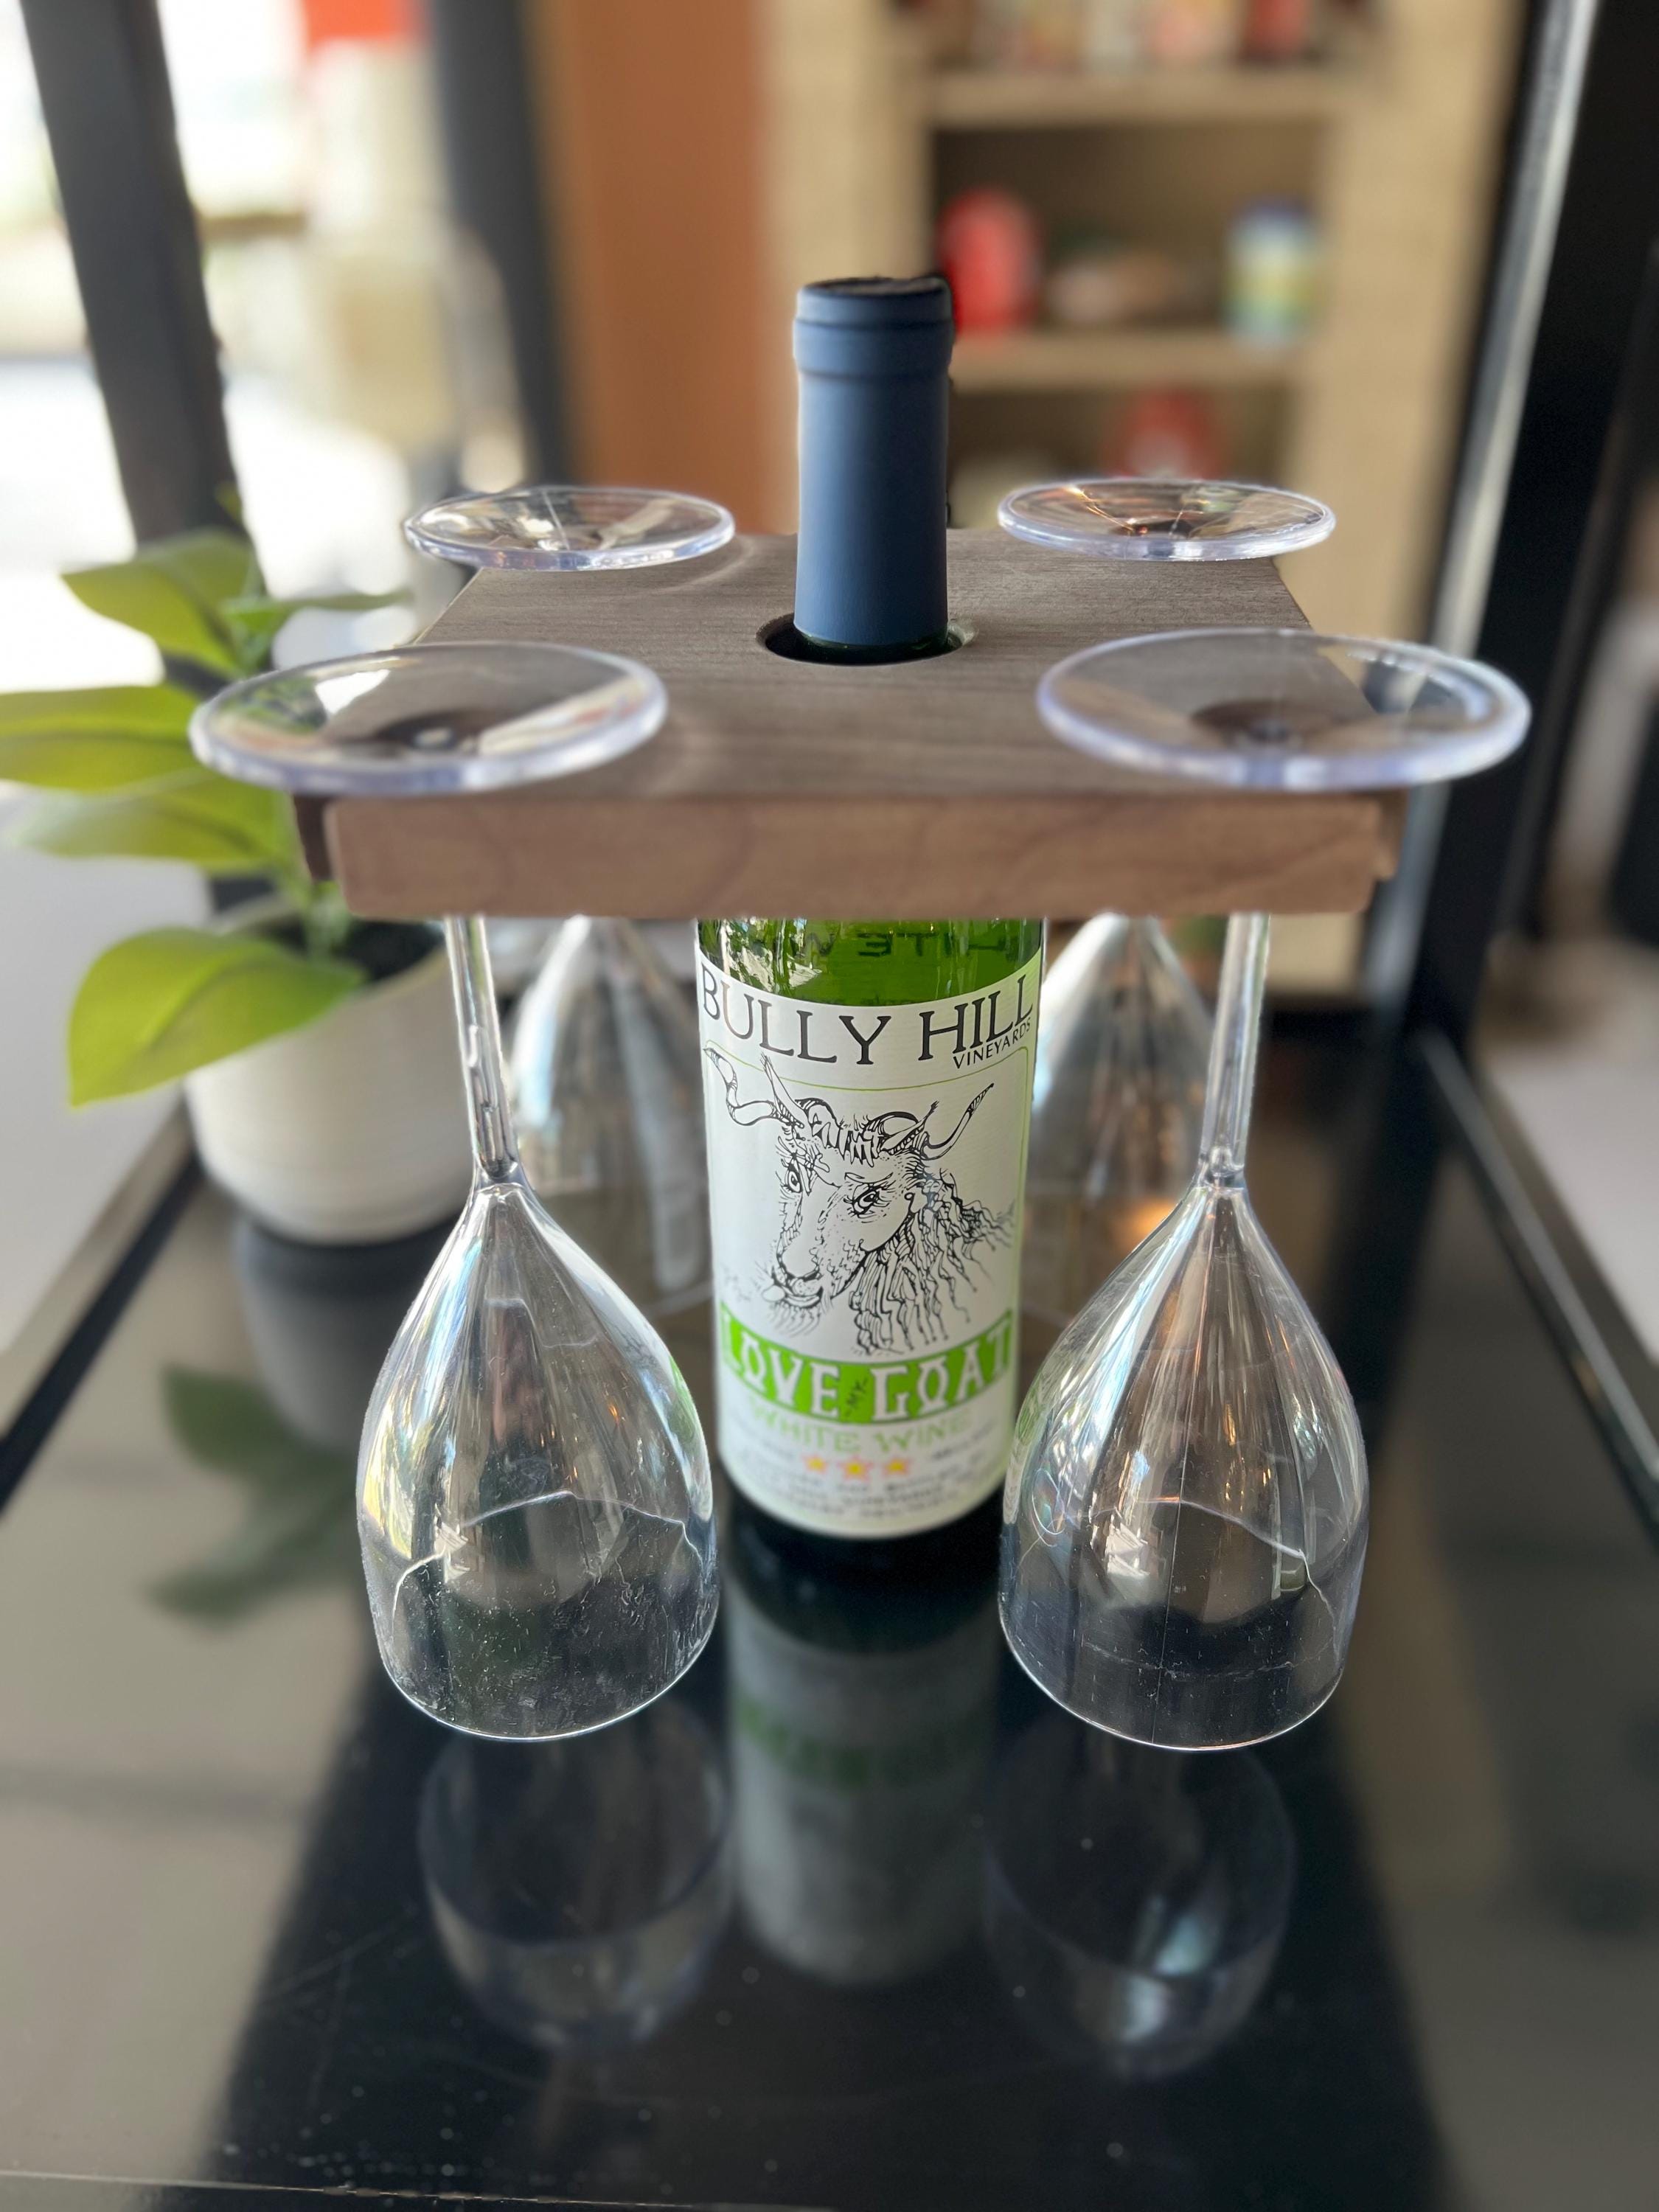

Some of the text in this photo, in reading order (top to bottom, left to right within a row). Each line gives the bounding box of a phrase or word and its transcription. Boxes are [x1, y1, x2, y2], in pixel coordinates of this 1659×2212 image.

[701, 962, 1034, 1065] BULLY HILL
[952, 1016, 1032, 1069] VINEYARDS
[721, 1311, 840, 1419] LOVE
[870, 1315, 1008, 1422] GOAT
[751, 1403, 861, 1452] WHITE
[874, 1408, 971, 1453] WINE
